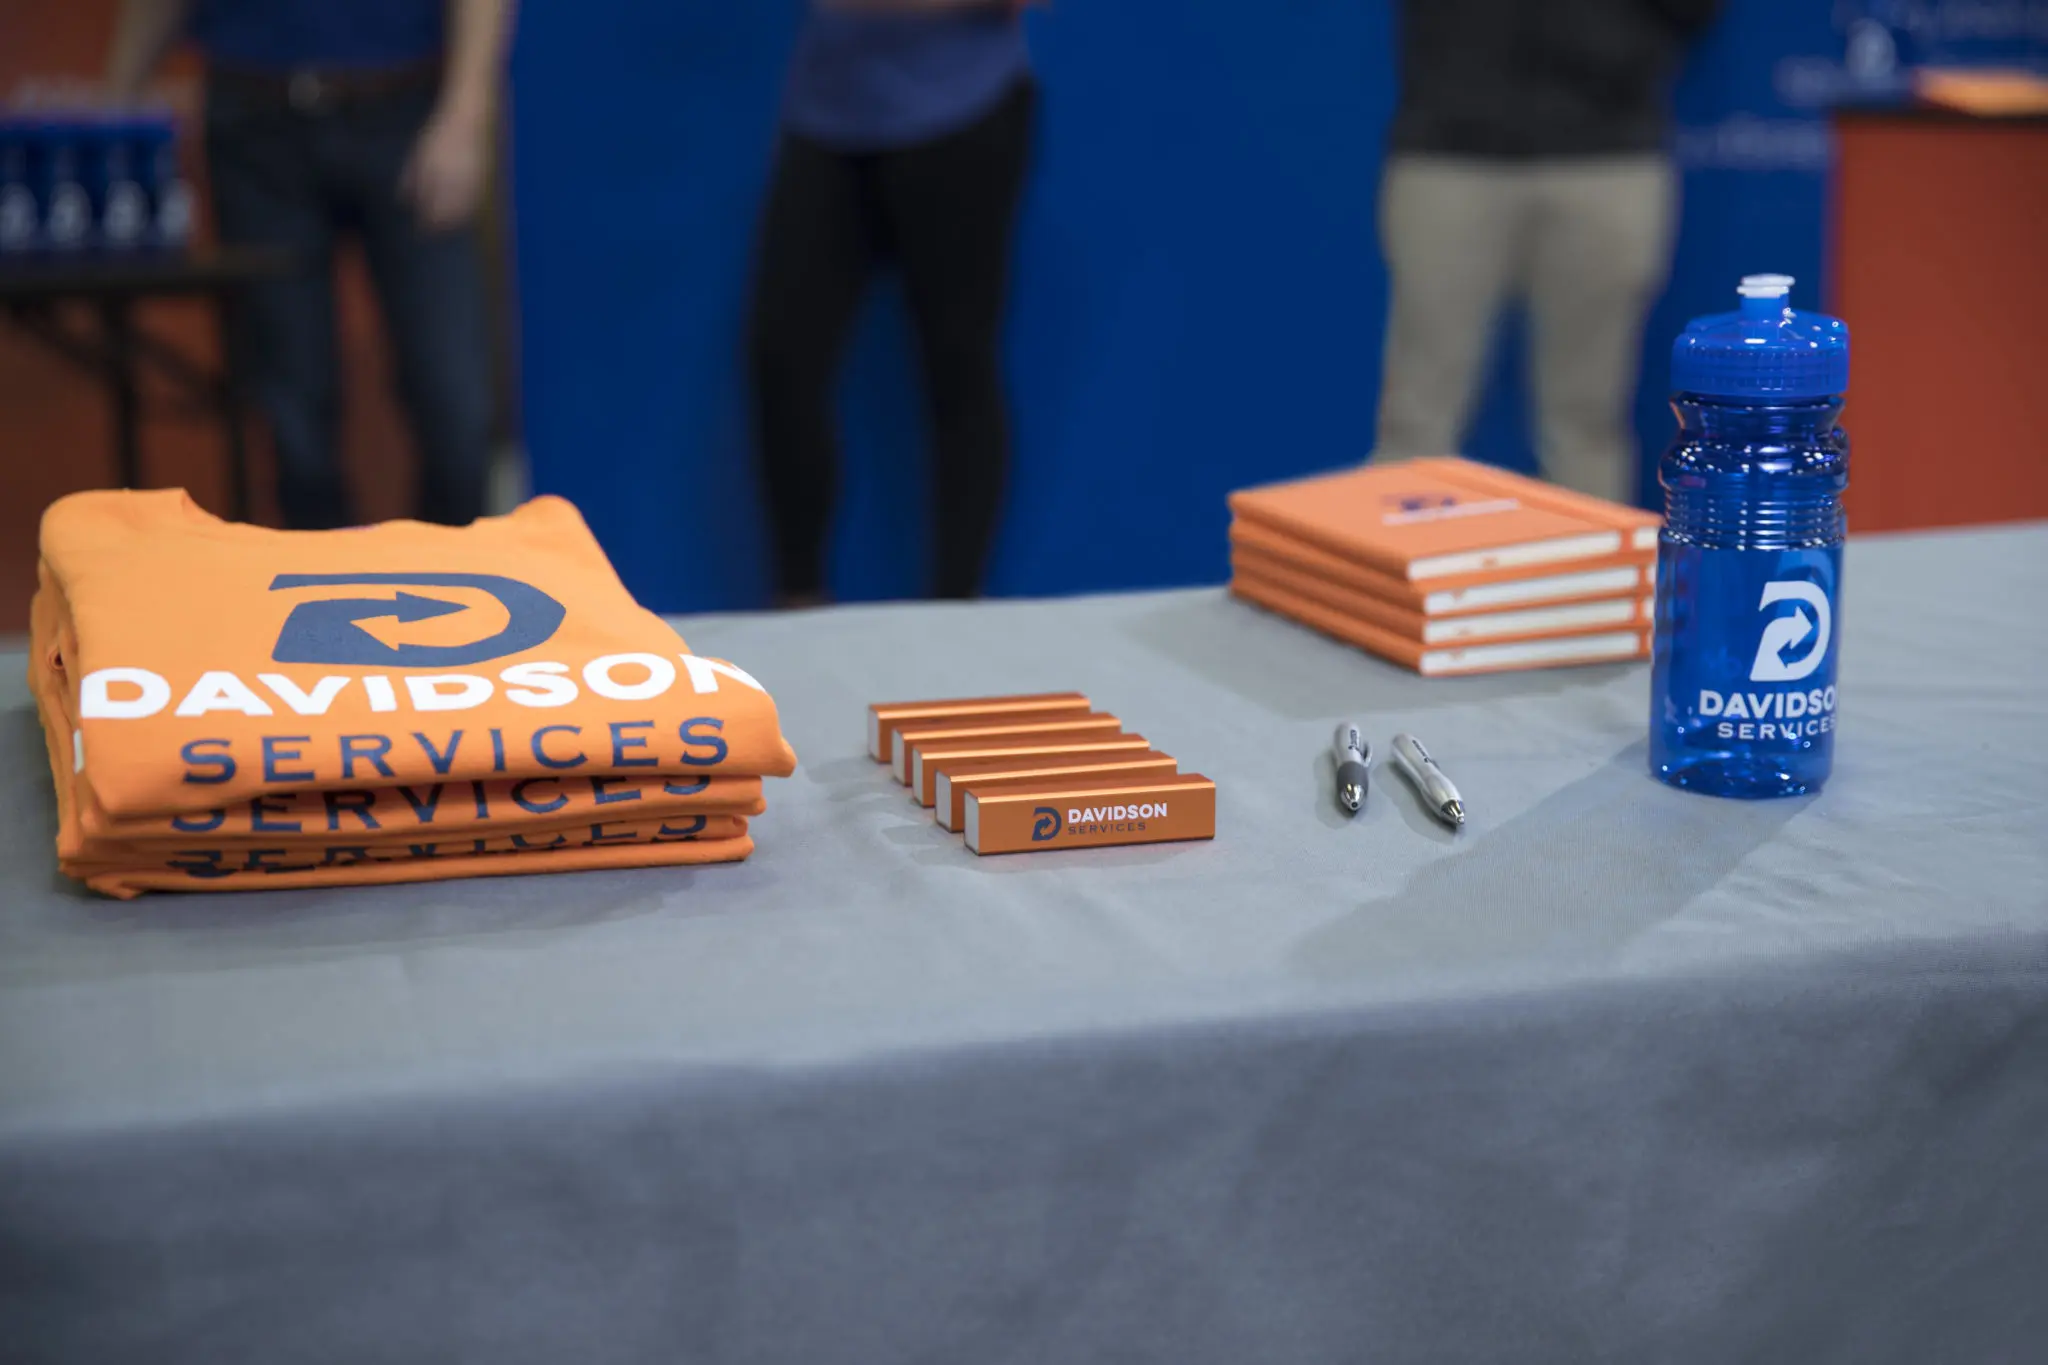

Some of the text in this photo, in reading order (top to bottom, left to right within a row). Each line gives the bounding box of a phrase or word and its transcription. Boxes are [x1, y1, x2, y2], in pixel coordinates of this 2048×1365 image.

[1699, 684, 1836, 719] DAVIDSO
[179, 716, 729, 785] SERVICES
[1067, 802, 1168, 824] DAVIDSON
[1067, 821, 1147, 835] SERVICES
